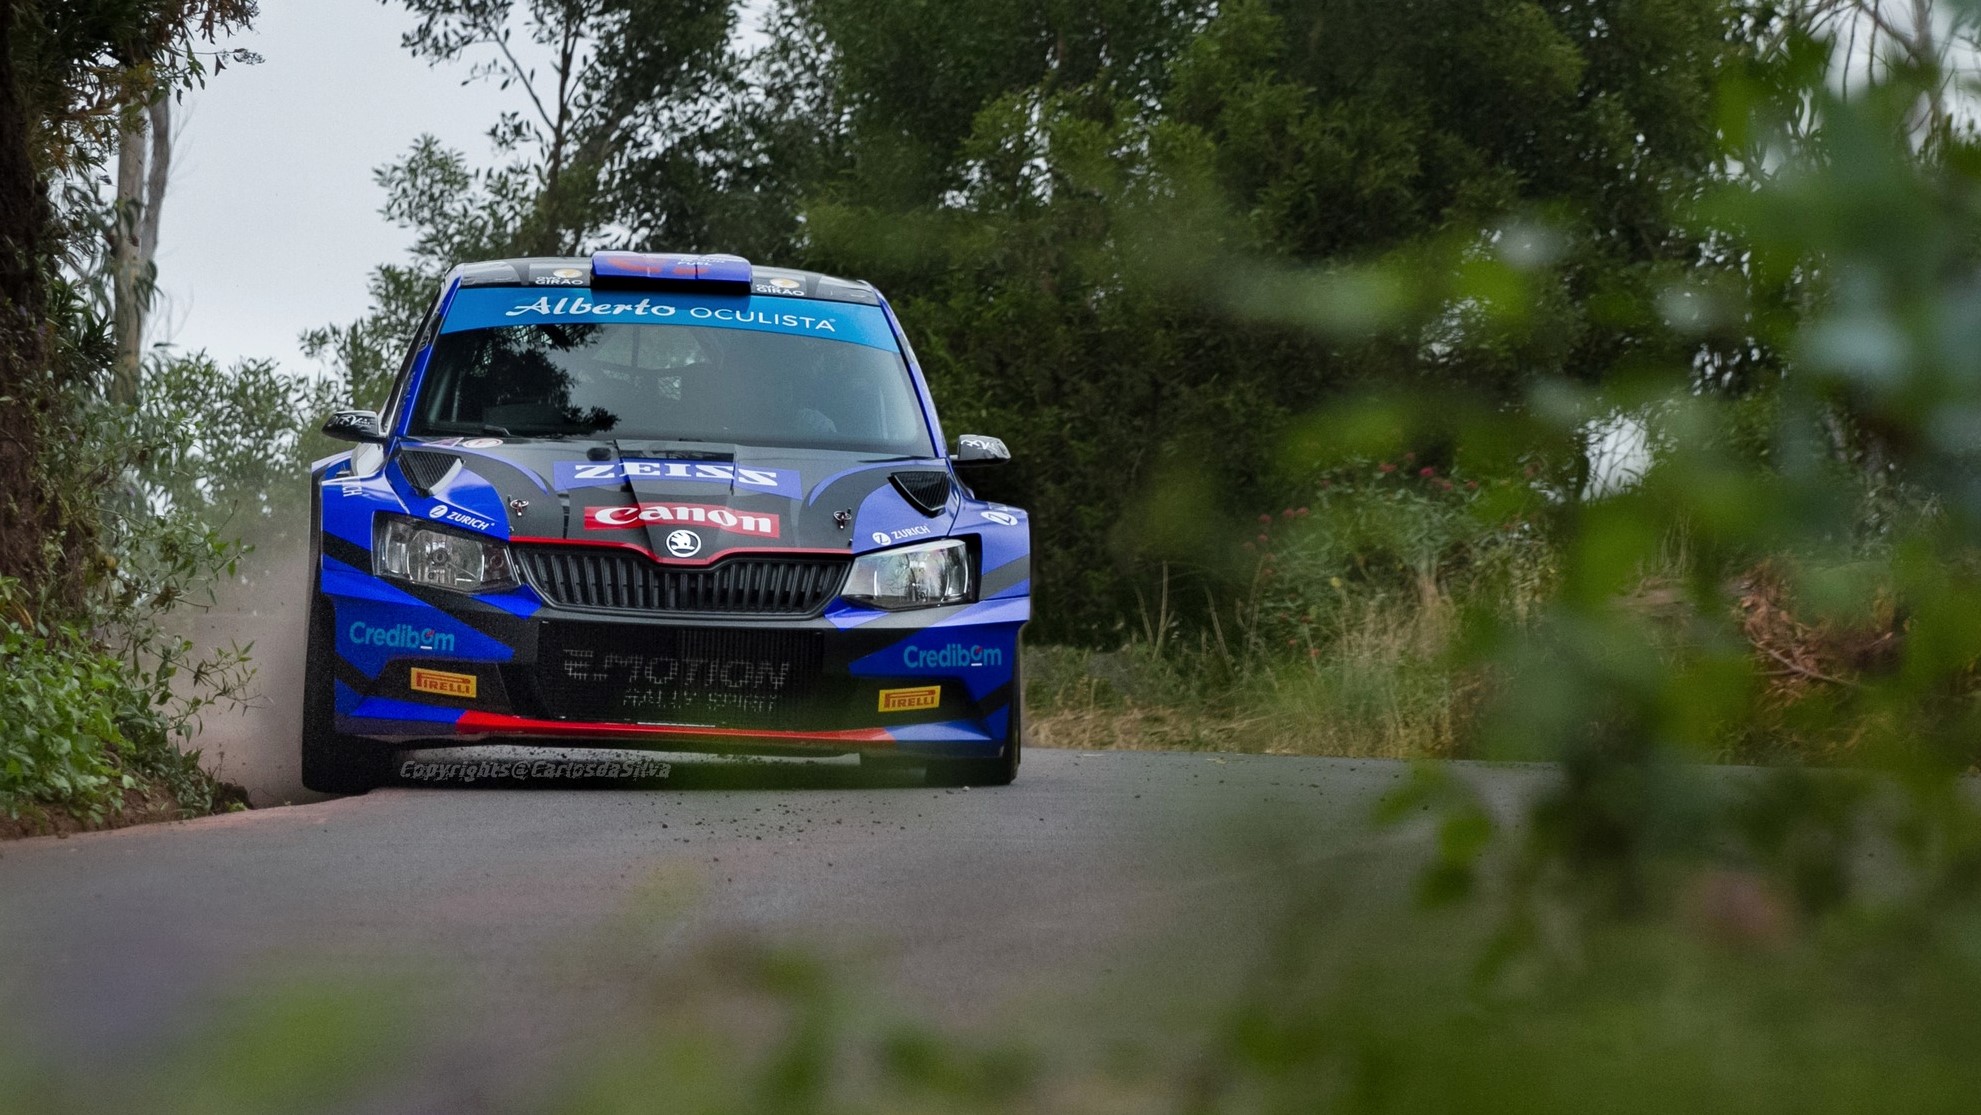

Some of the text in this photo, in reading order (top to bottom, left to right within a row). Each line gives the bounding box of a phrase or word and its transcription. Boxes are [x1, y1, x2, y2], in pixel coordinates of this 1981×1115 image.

[505, 296, 835, 332] Alberto OCULISTA
[574, 462, 778, 486] ZEISS
[447, 511, 490, 530] ZURICH
[595, 506, 771, 533] Canon
[891, 526, 931, 540] ZURICH
[415, 671, 471, 694] PIRELLI
[884, 689, 936, 708] PIRELLI
